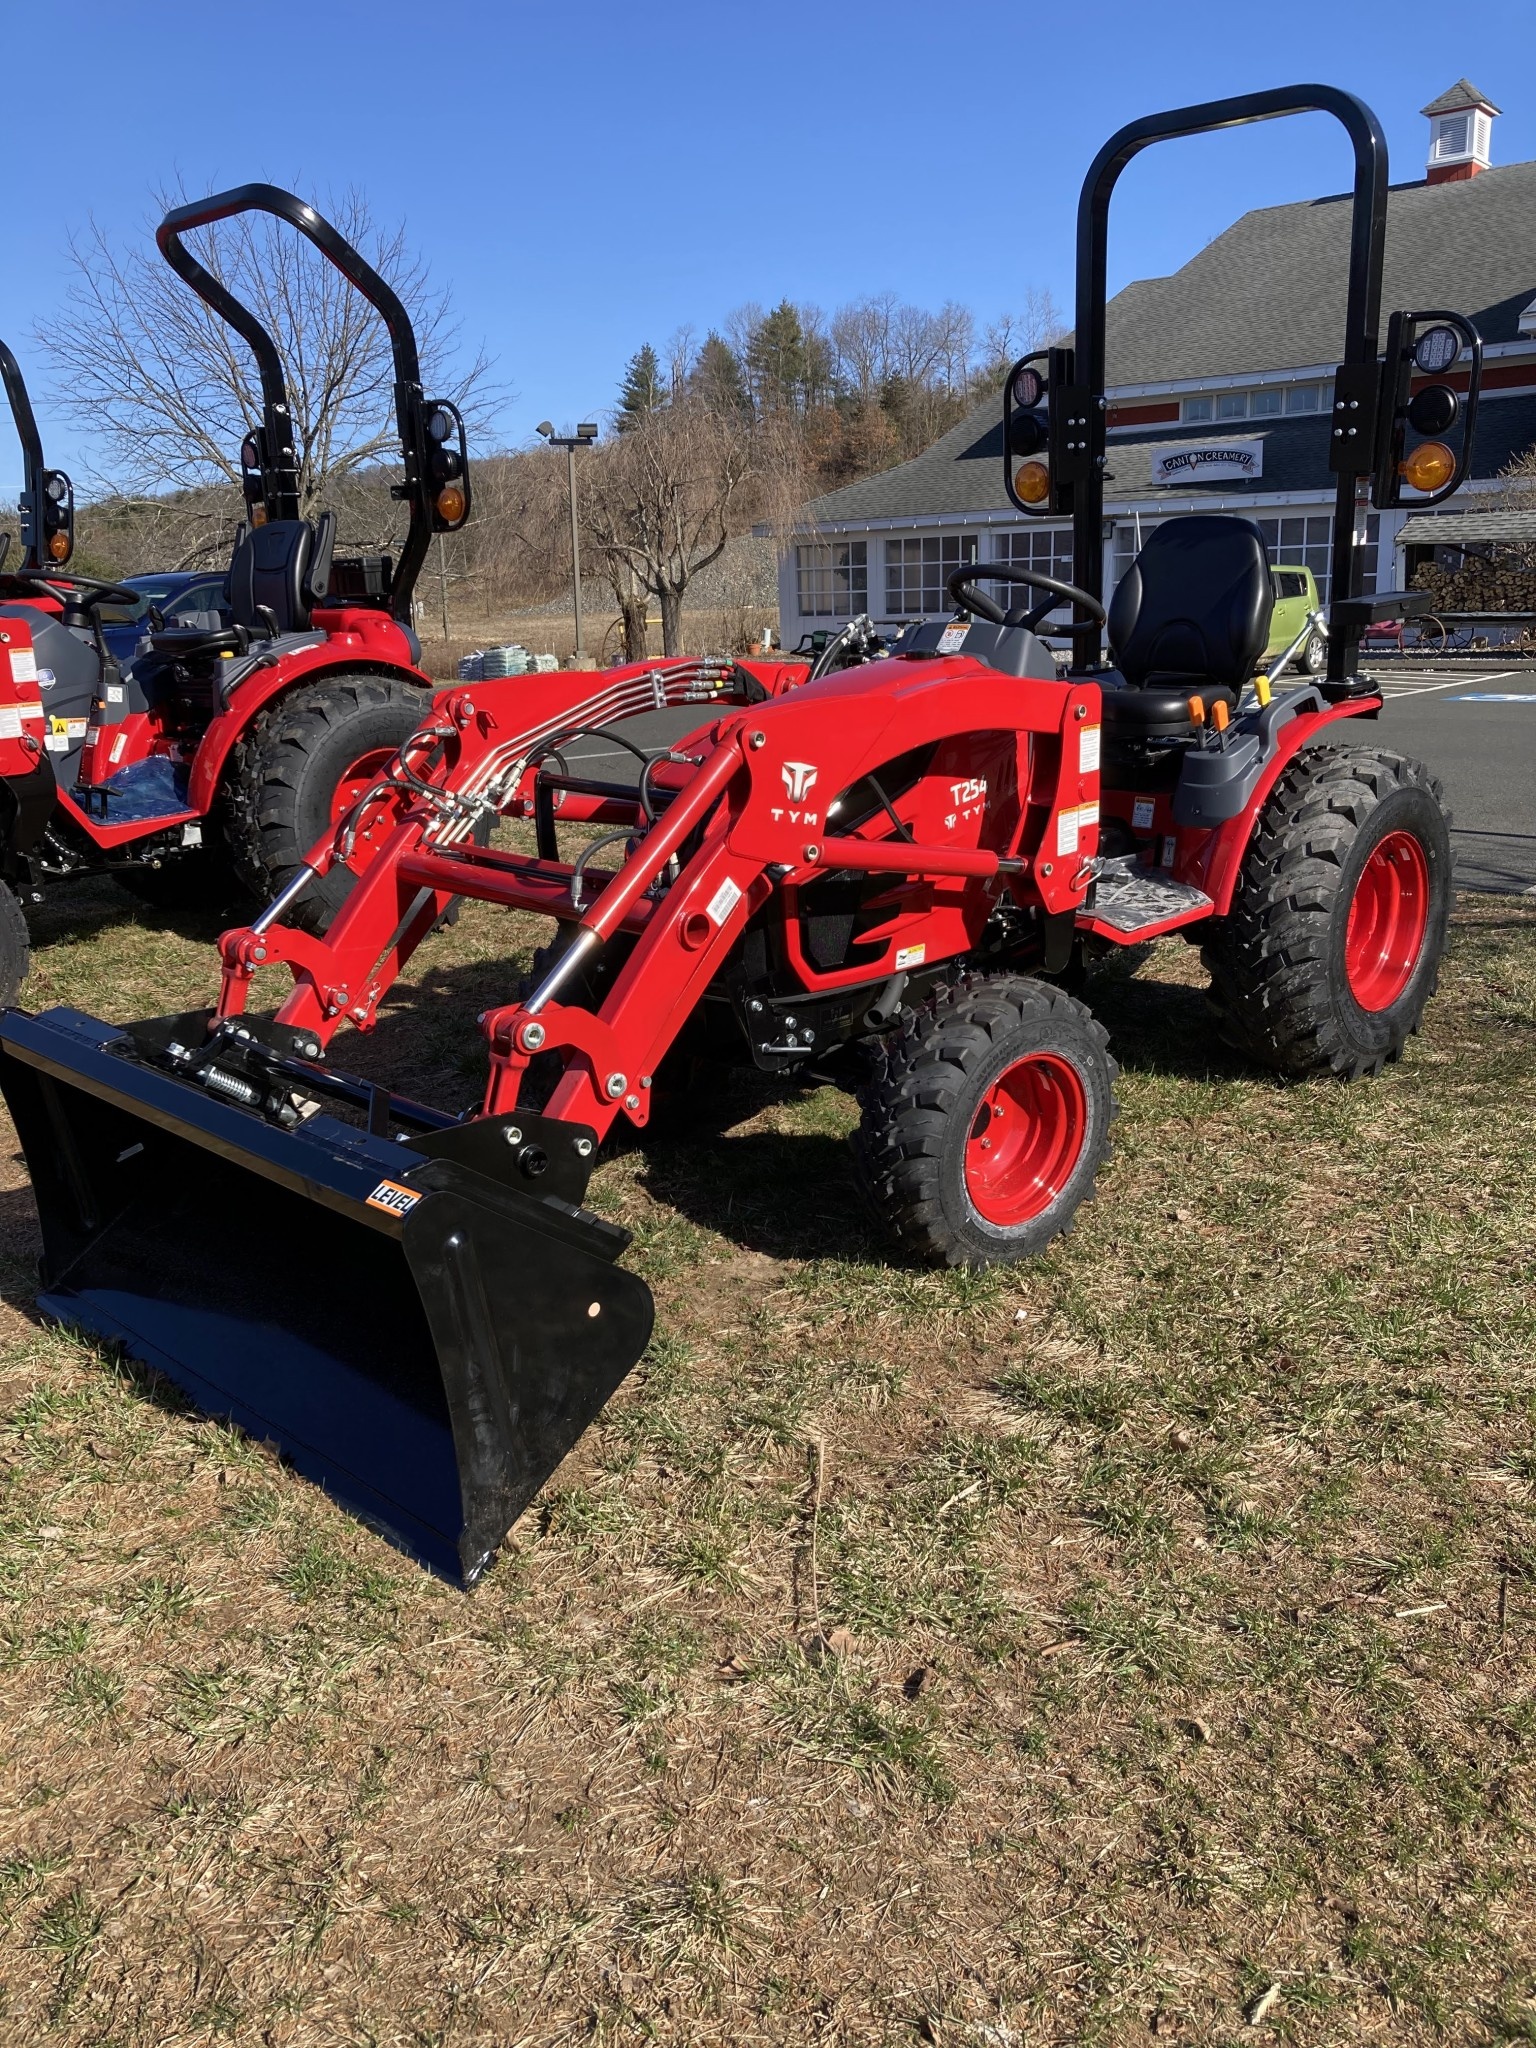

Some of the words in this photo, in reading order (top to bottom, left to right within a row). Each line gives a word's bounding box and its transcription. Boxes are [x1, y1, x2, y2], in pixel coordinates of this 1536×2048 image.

[1205, 451, 1251, 464] CREAMERY
[950, 775, 987, 806] T254
[771, 808, 818, 826] TYM
[962, 800, 991, 820] TYM
[371, 1185, 414, 1213] LEVEL
